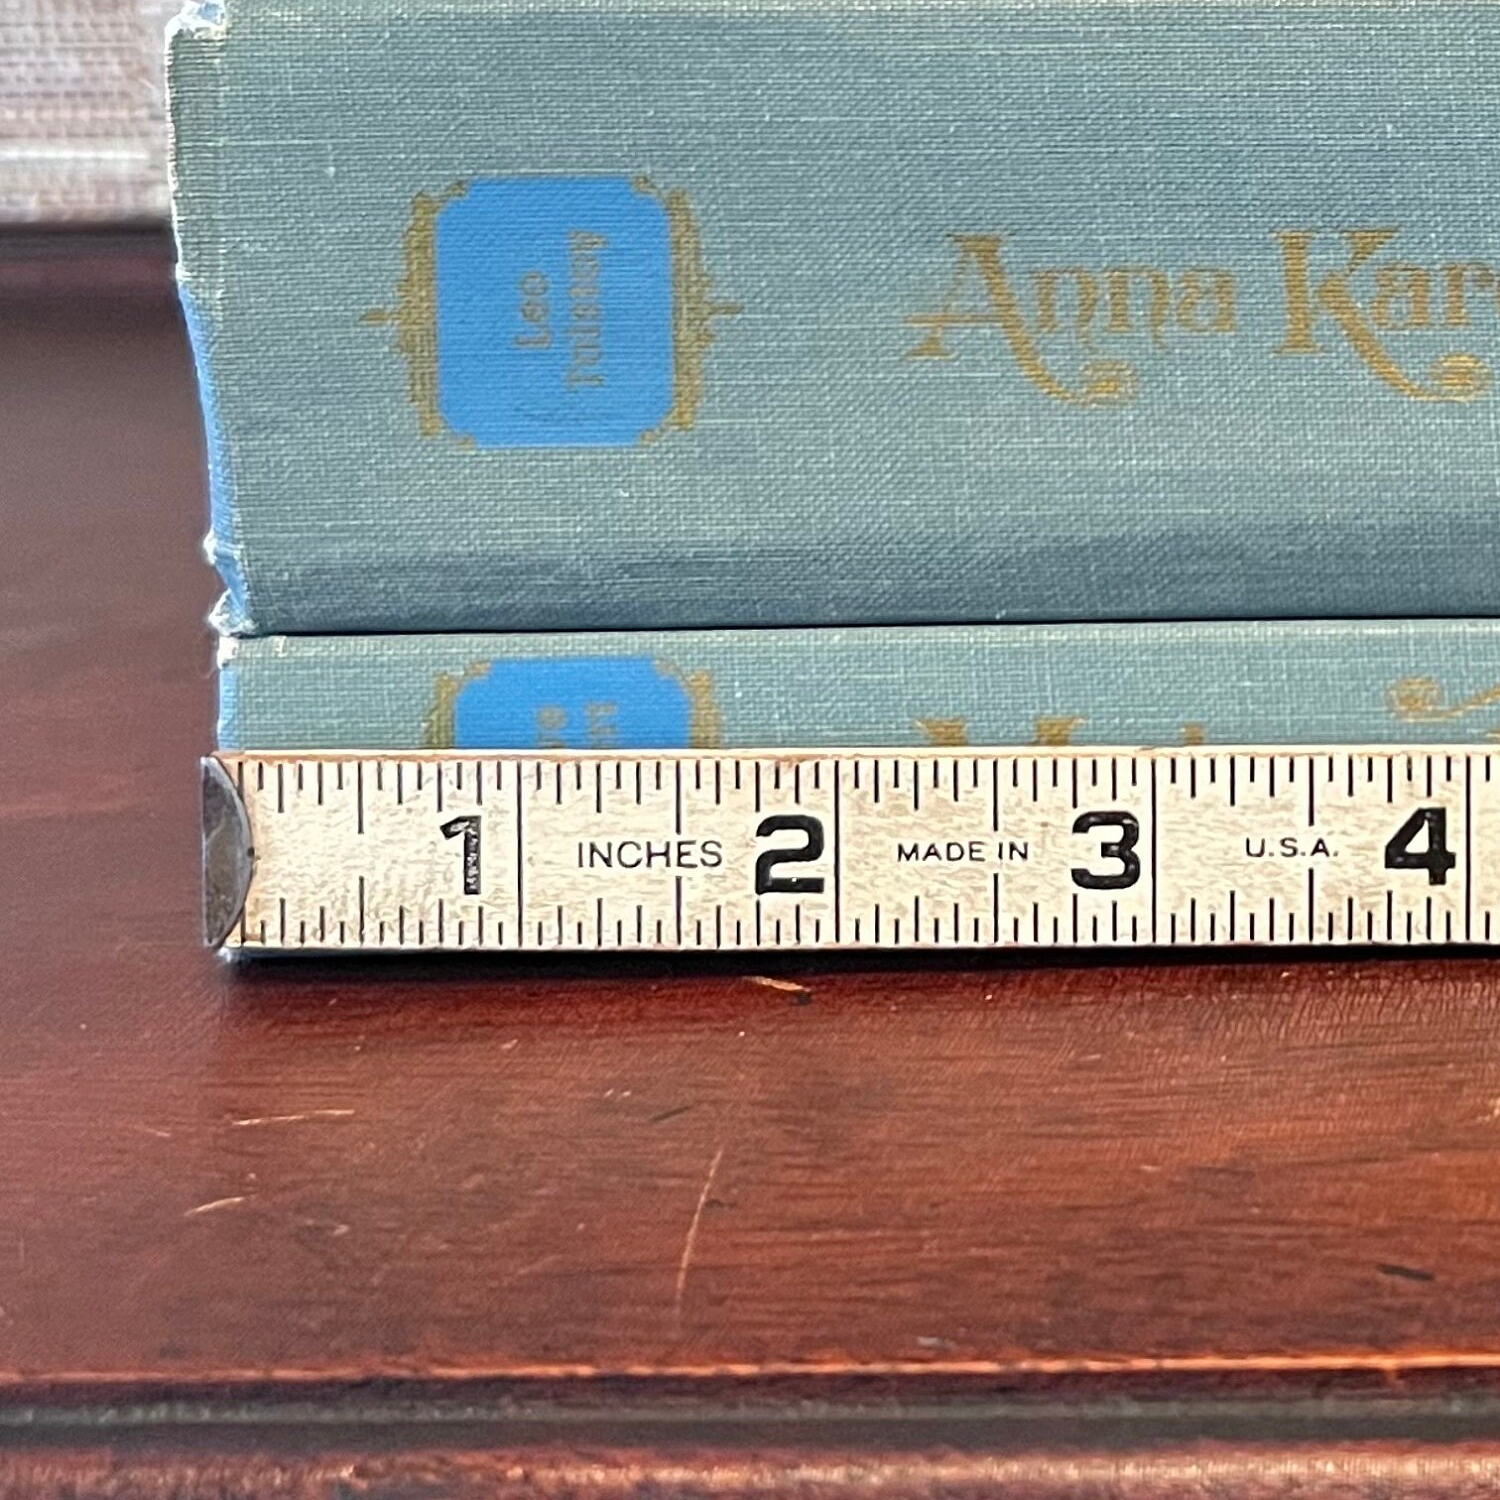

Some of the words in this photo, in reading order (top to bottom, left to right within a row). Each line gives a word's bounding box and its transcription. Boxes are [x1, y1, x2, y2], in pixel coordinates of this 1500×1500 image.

[512, 269, 552, 350] Leo
[902, 231, 1237, 407] Anna
[439, 815, 482, 895] 1
[577, 839, 724, 869] INCHES
[754, 814, 825, 895] 2
[897, 840, 986, 863] MADE
[998, 840, 1029, 862] IN
[1070, 810, 1141, 891] 3
[1244, 836, 1340, 860] U.S.A.
[1383, 806, 1457, 886] 4
